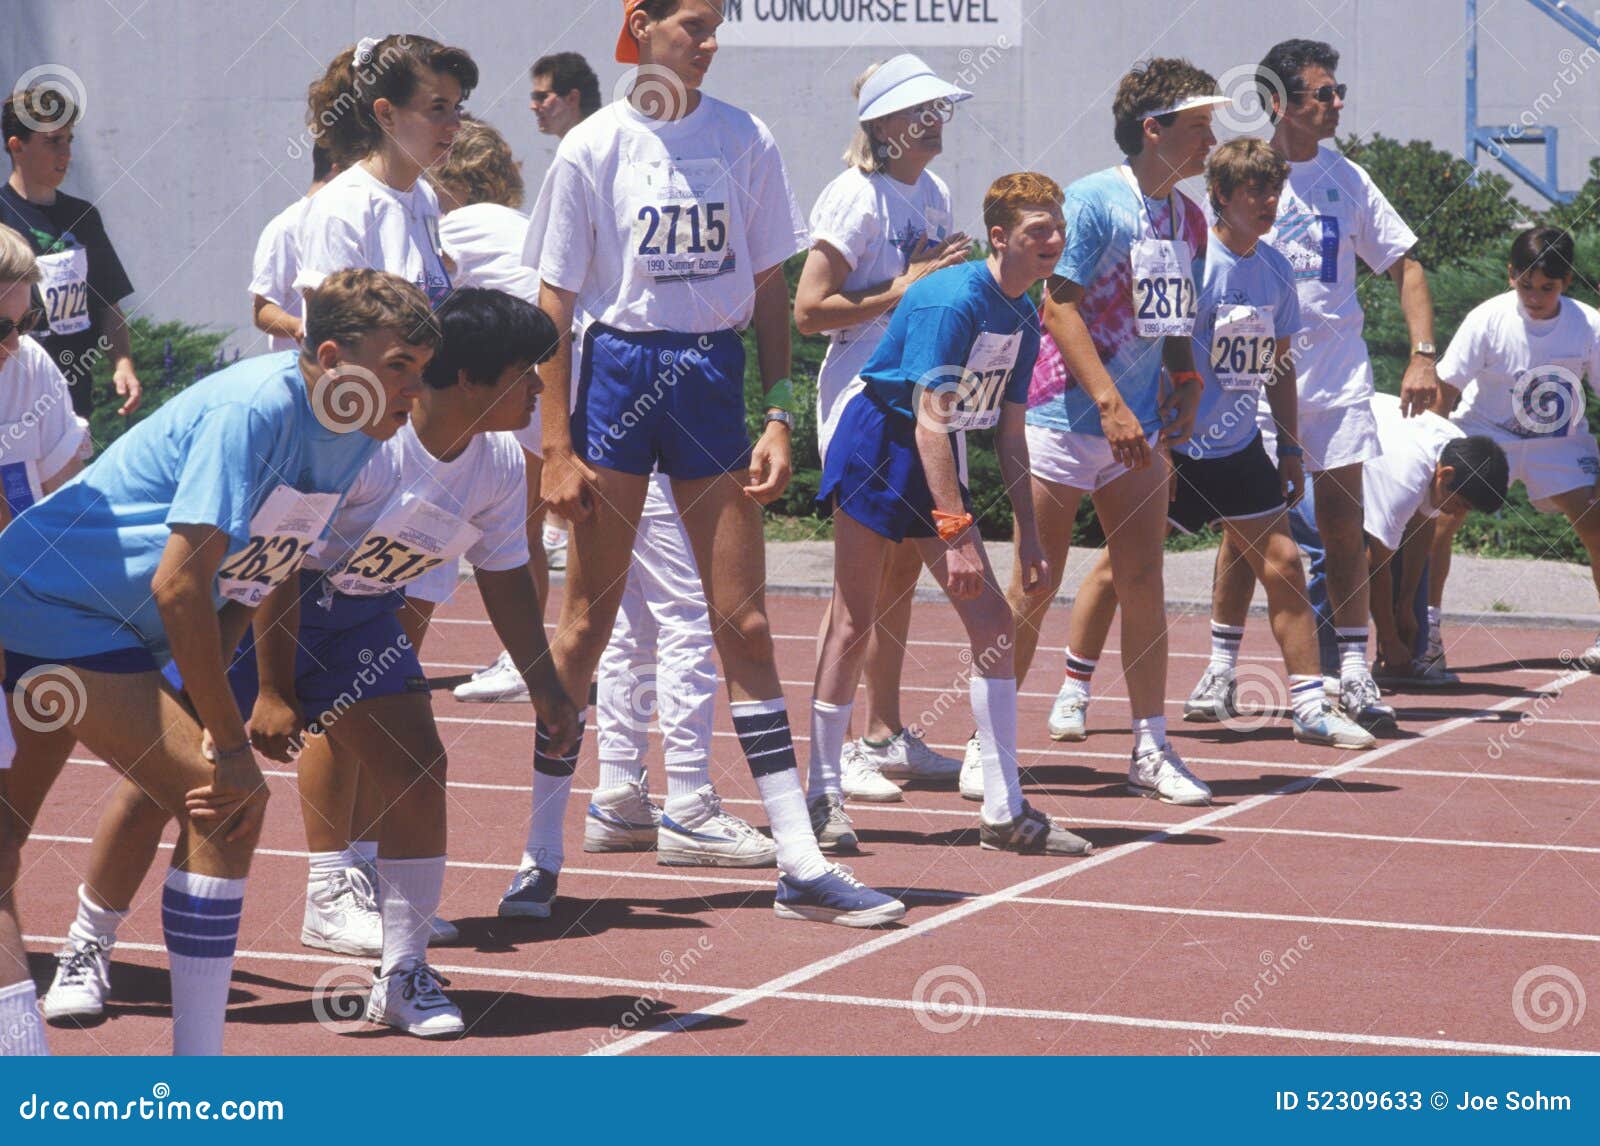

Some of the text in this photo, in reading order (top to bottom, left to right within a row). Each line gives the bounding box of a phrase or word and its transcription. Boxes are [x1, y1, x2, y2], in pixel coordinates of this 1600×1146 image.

[722, 0, 998, 22] N CONCOURSE LEVEL
[638, 202, 726, 255] 2715
[647, 258, 720, 272] 1990 Summer Games
[46, 281, 87, 323] 2722
[1137, 277, 1196, 319] 2872
[1214, 336, 1275, 374] 2612
[957, 369, 1012, 411] 277
